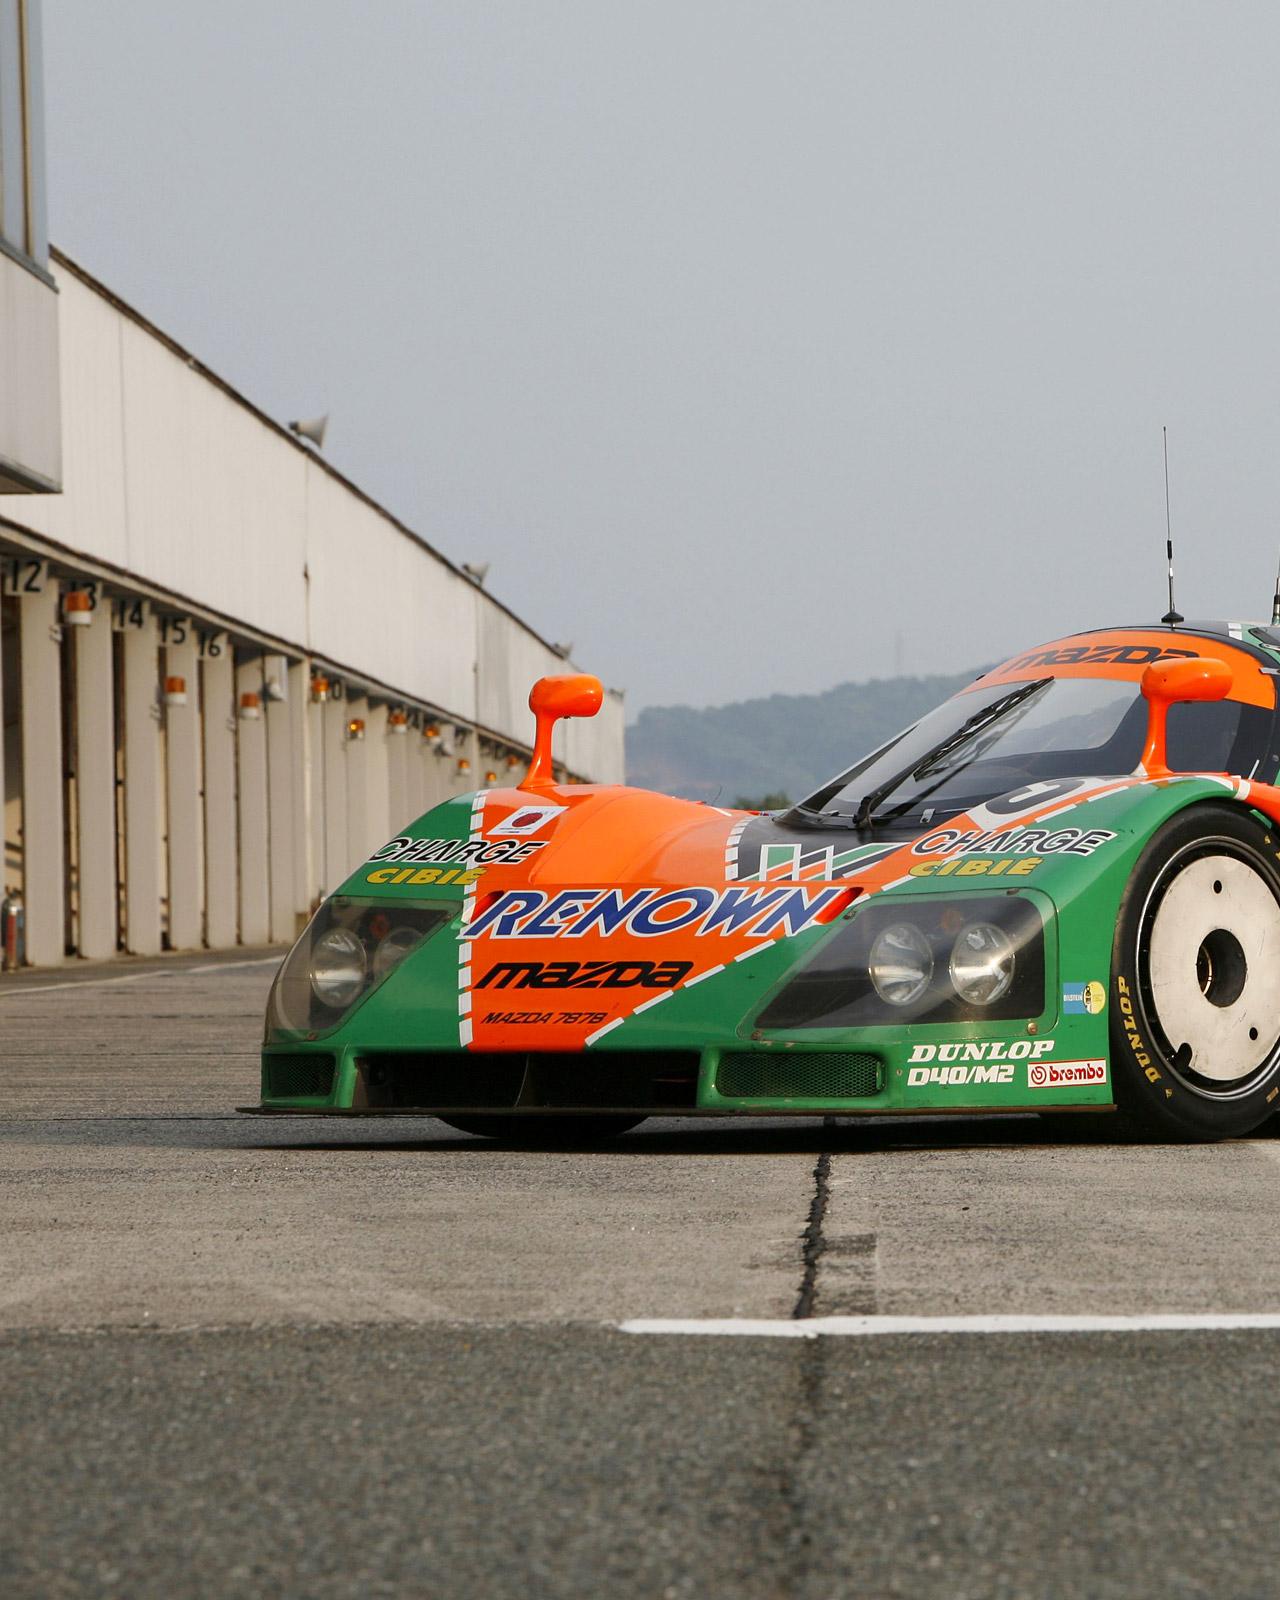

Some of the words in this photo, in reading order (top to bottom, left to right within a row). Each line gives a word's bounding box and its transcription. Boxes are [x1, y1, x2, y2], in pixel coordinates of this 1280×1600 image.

[11, 559, 42, 592] 12
[118, 600, 143, 629] 14
[160, 618, 186, 644] 15
[198, 633, 221, 657] 16
[368, 837, 550, 865] CHARGE
[911, 828, 1118, 857] CHARGE
[458, 886, 846, 940] RENOWN
[474, 961, 695, 989] mazda
[480, 1012, 553, 1024] MAZDA
[1118, 975, 1162, 1083] DUNLOP
[907, 1040, 1055, 1062] DUNLOP
[907, 1065, 1015, 1086] D40/M2
[1049, 1063, 1104, 1082] brembo
